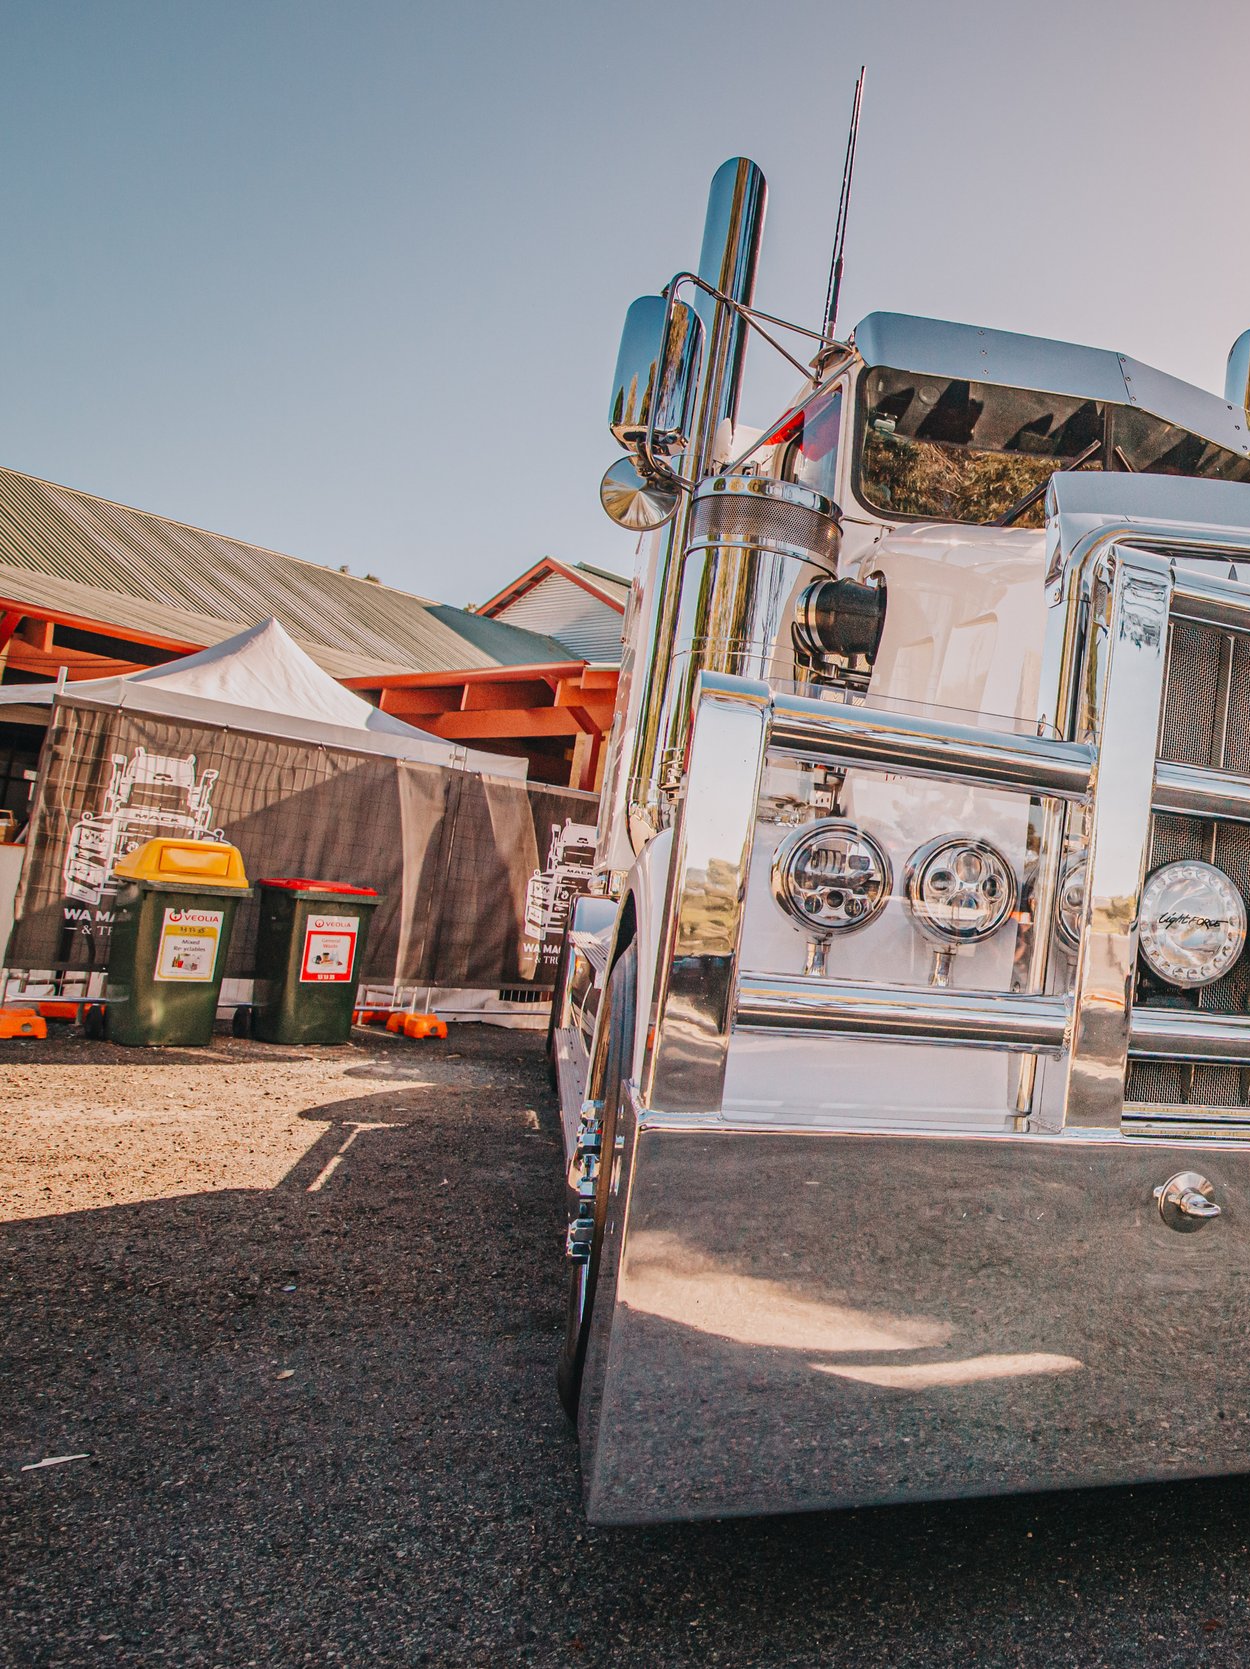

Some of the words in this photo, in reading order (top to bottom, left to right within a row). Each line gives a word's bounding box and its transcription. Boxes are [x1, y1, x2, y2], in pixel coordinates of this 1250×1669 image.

[135, 812, 181, 823] MACK
[566, 868, 594, 876] MACK
[63, 907, 92, 921] WA
[184, 914, 219, 923] VEOLIA
[81, 924, 93, 935] &
[523, 942, 541, 953] WA
